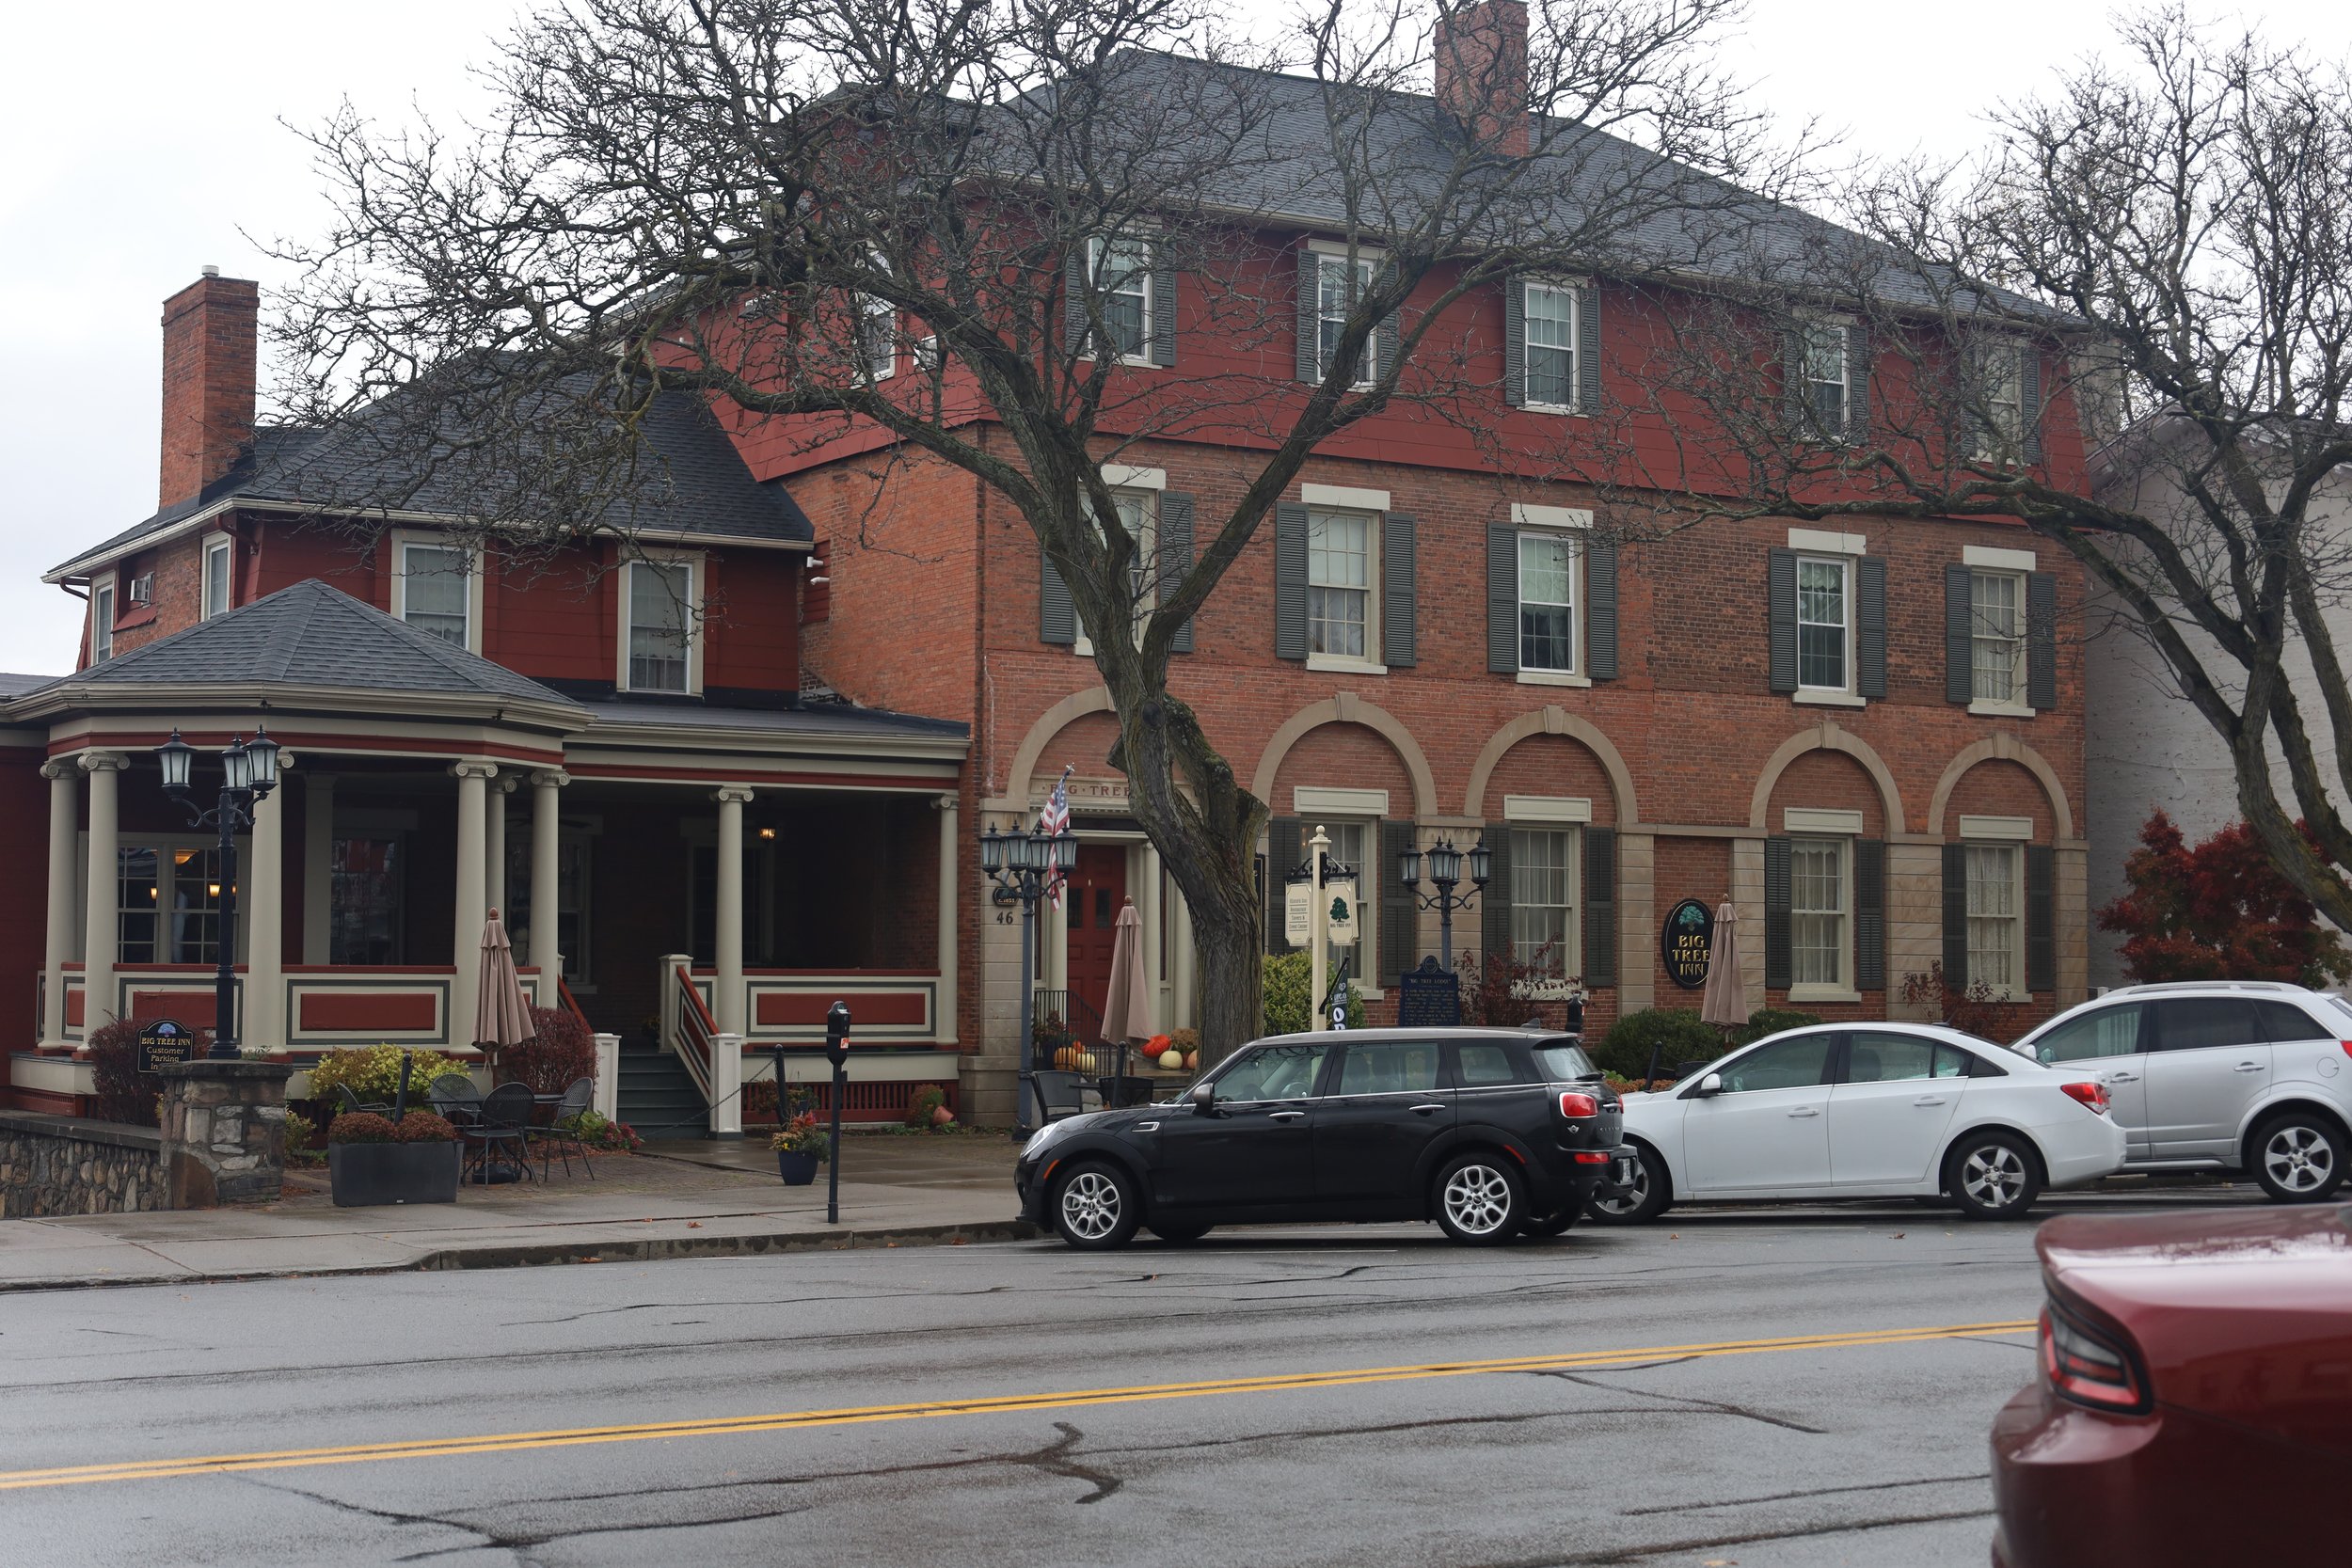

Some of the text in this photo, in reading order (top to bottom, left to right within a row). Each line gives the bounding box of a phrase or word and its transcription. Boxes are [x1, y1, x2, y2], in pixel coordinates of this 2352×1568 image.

[1050, 784, 1077, 795] BG
[996, 911, 1013, 925] 46
[1678, 935, 1705, 947] BIG
[1672, 949, 1710, 962] TREE
[1679, 963, 1704, 975] INN
[141, 1037, 155, 1045] BIG
[147, 1046, 184, 1054] Customer
